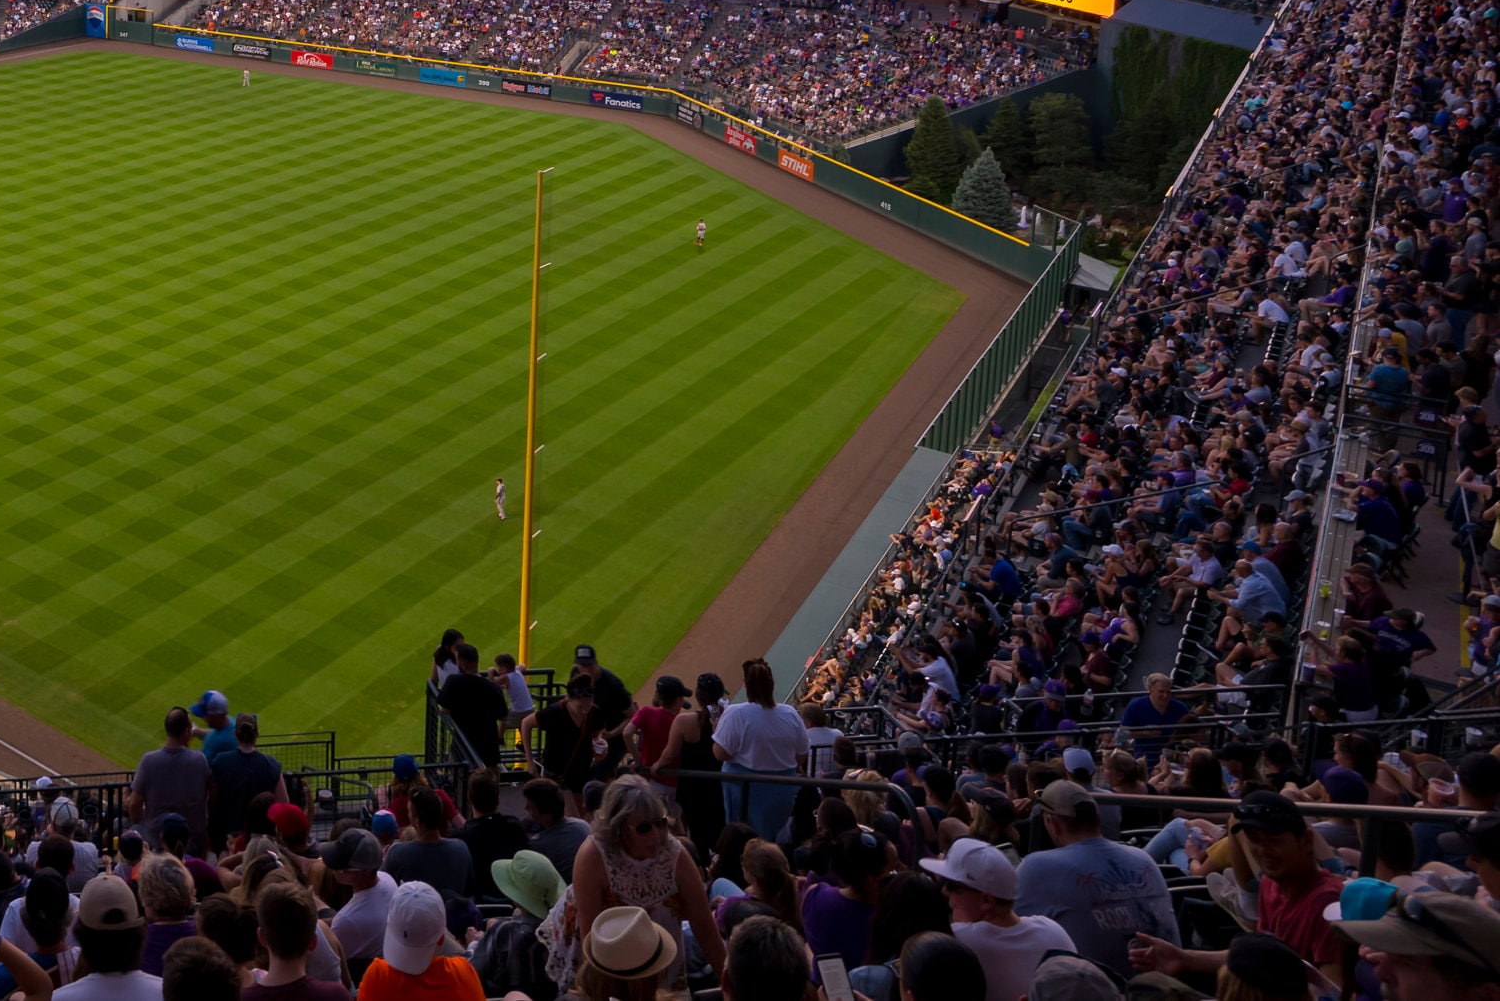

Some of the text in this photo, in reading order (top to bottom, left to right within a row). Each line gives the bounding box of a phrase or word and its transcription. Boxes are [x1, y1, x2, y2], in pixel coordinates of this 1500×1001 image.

[297, 56, 327, 68] Red Robin
[527, 84, 550, 95] Mobil
[604, 96, 641, 110] Fanatics
[780, 154, 810, 177] STIHL
[880, 201, 892, 211] 415
[1418, 443, 1436, 454] 309
